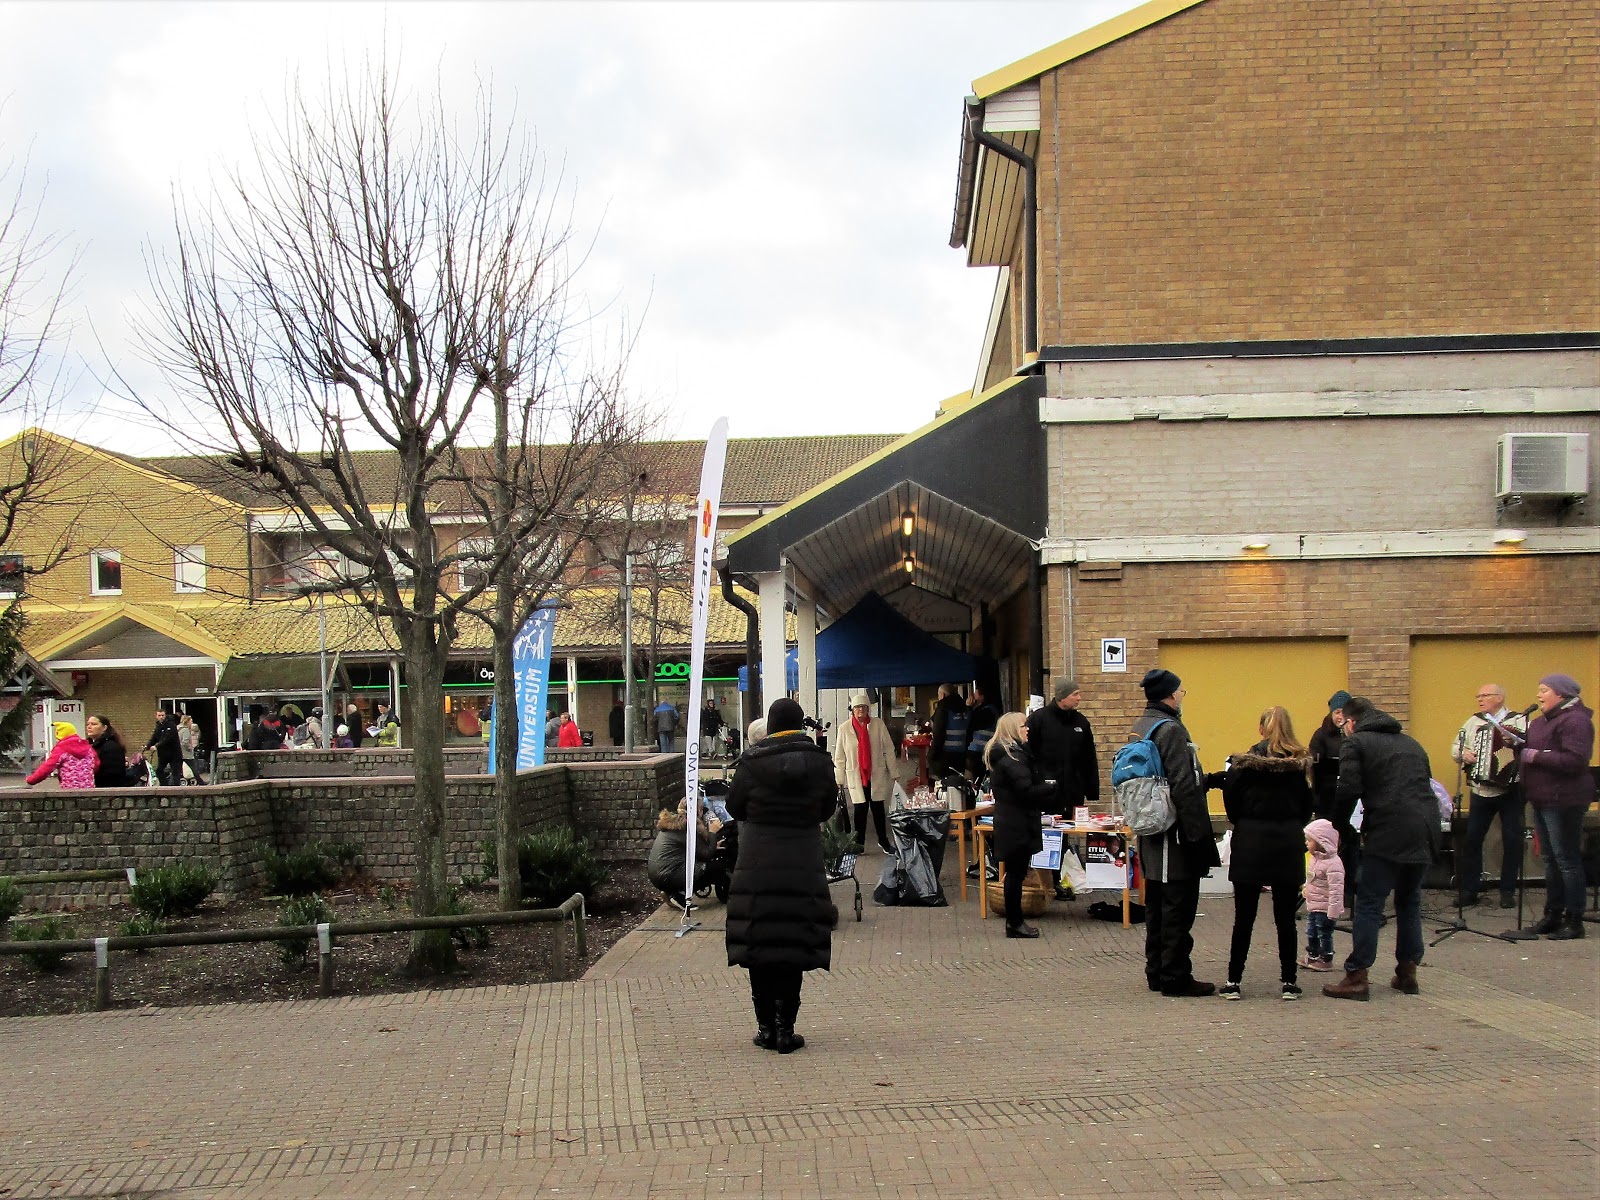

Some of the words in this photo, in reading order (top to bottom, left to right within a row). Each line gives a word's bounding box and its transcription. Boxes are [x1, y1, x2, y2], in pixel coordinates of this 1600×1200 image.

[480, 668, 495, 680] Öp
[655, 662, 692, 677] coo
[520, 668, 543, 768] UNIVERSUM
